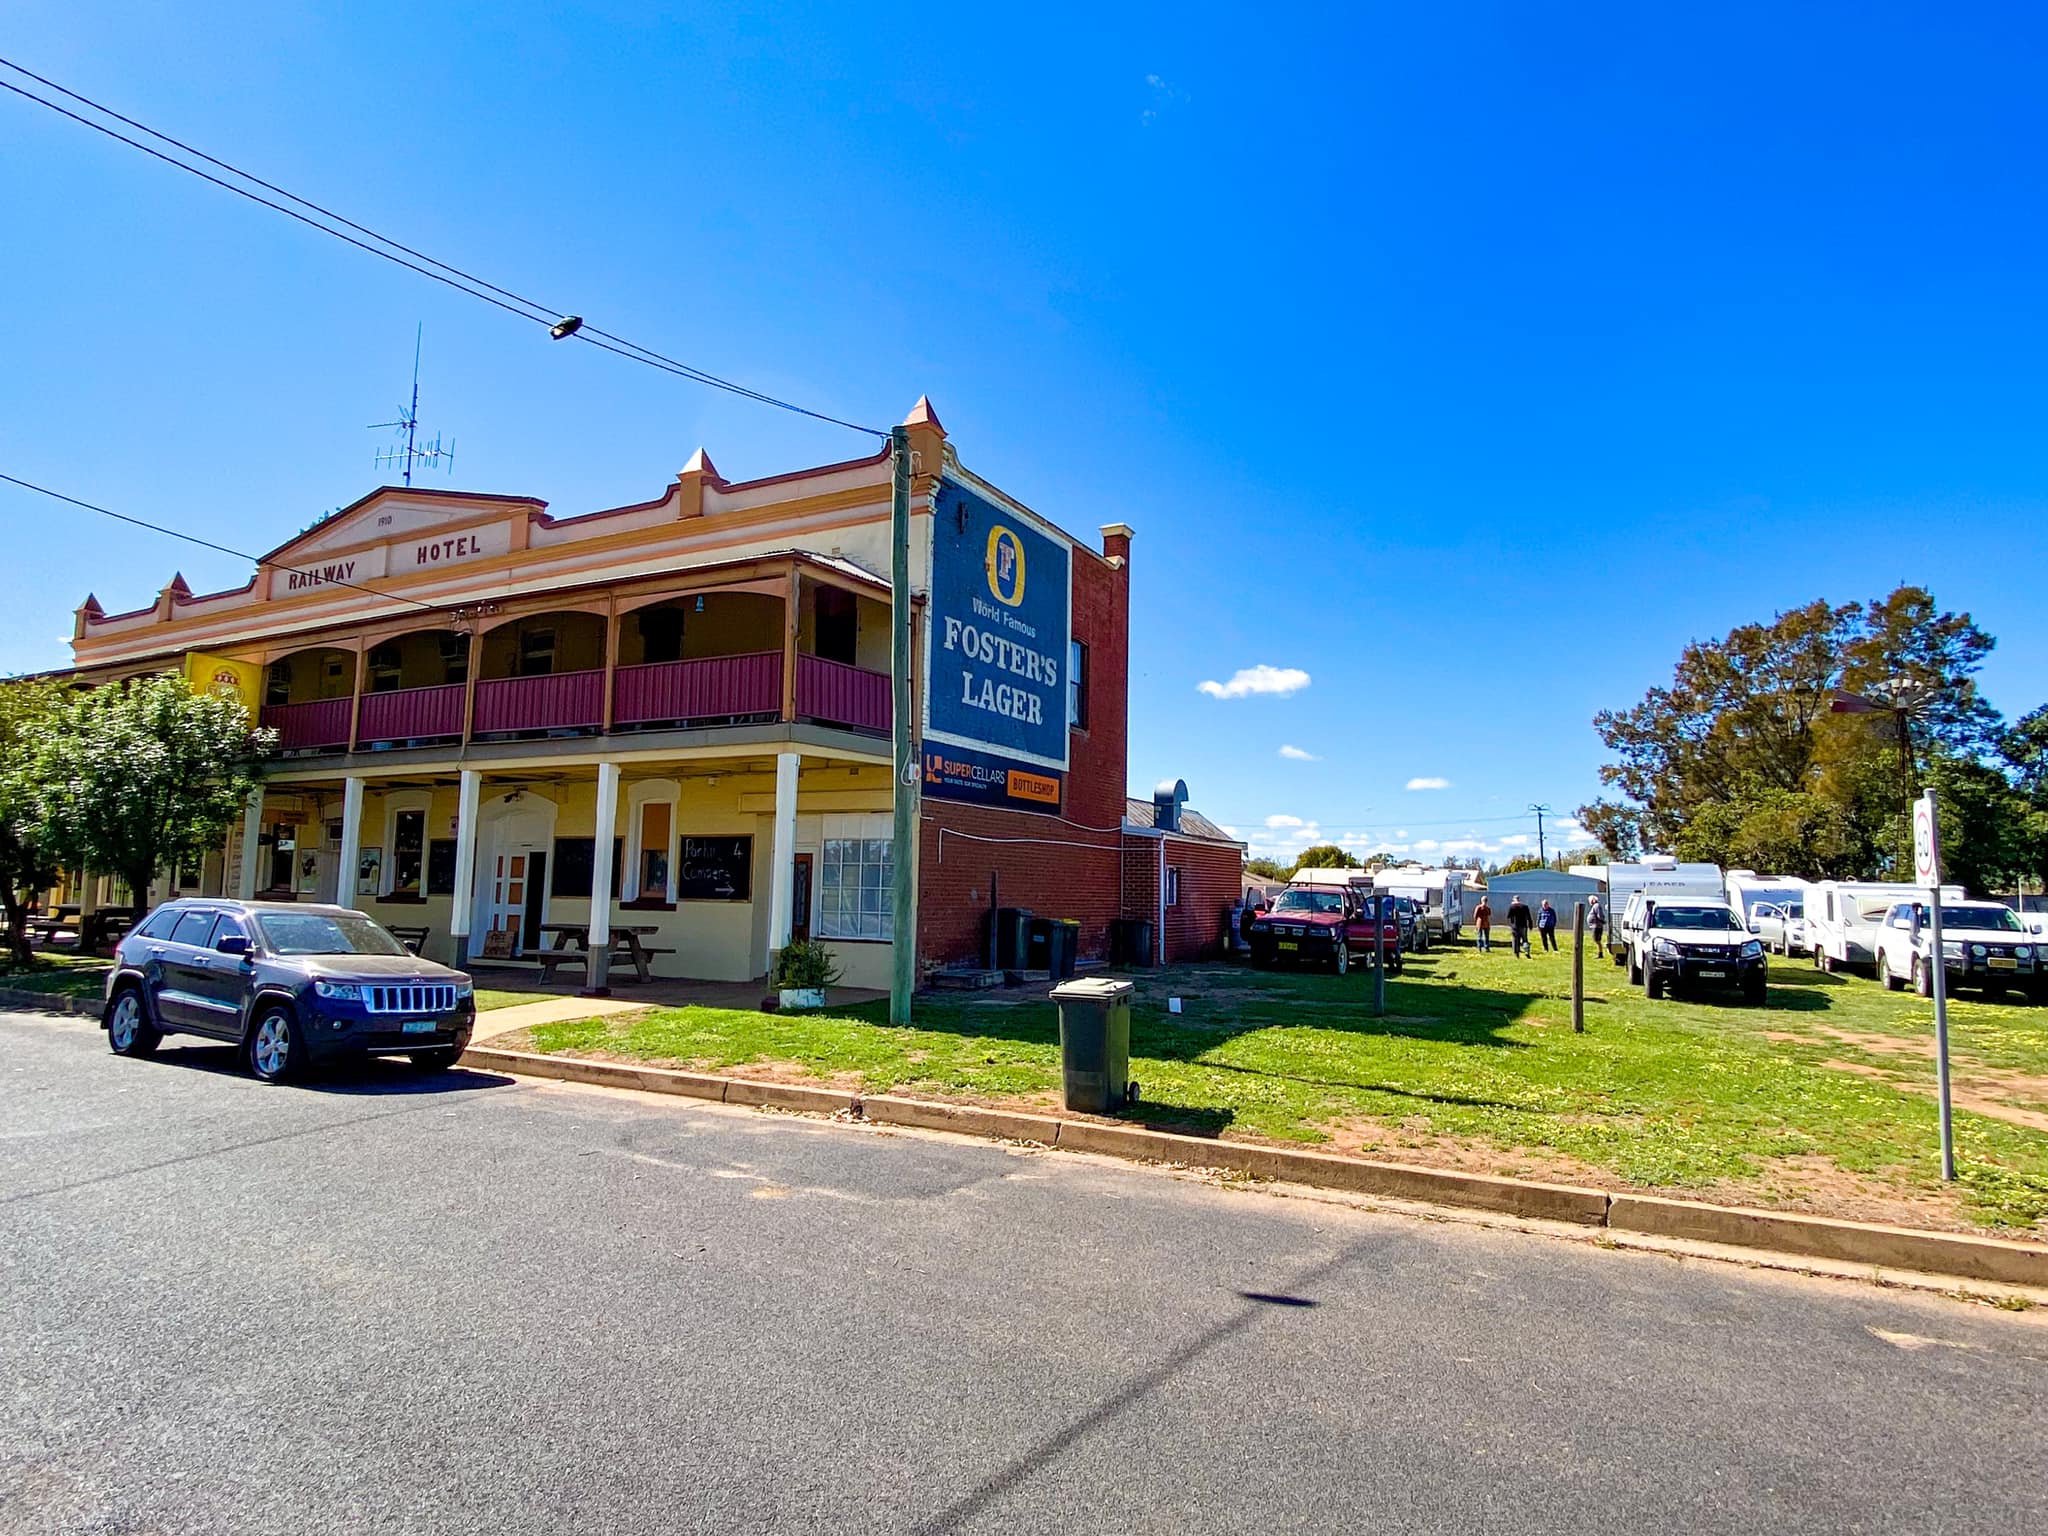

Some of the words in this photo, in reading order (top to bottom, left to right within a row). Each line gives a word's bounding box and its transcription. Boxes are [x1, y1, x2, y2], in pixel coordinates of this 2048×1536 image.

[417, 535, 480, 564] HOTEL
[289, 561, 355, 590] RAILWAY
[972, 597, 1000, 623] World
[1003, 611, 1036, 638] Famous
[943, 615, 1057, 687] FOSTER'S
[961, 671, 1043, 725] LAGER
[944, 760, 1005, 784] SUPERCELLARS
[1013, 777, 1054, 795] BOTTLESHOP
